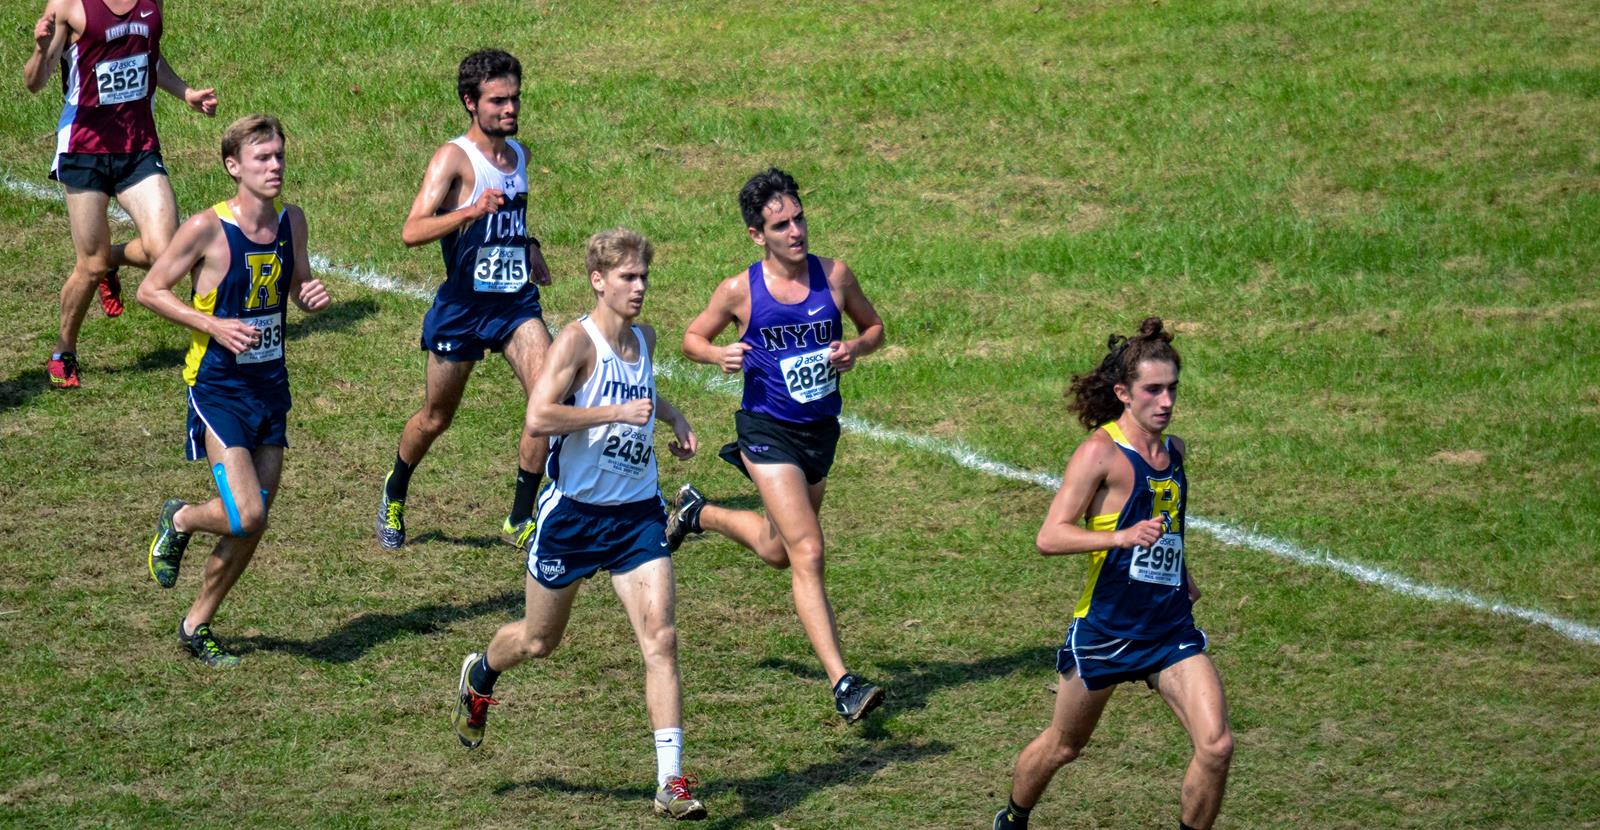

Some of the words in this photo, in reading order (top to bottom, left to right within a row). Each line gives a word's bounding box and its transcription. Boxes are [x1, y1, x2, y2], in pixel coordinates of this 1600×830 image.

[98, 65, 148, 94] 2527
[245, 251, 282, 311] R
[477, 258, 524, 281] 3215
[760, 319, 833, 352] NYU
[804, 353, 824, 365] asics
[631, 431, 648, 442] asics
[602, 434, 653, 469] 2434
[1146, 476, 1181, 534] R
[1134, 544, 1182, 573] 2991
